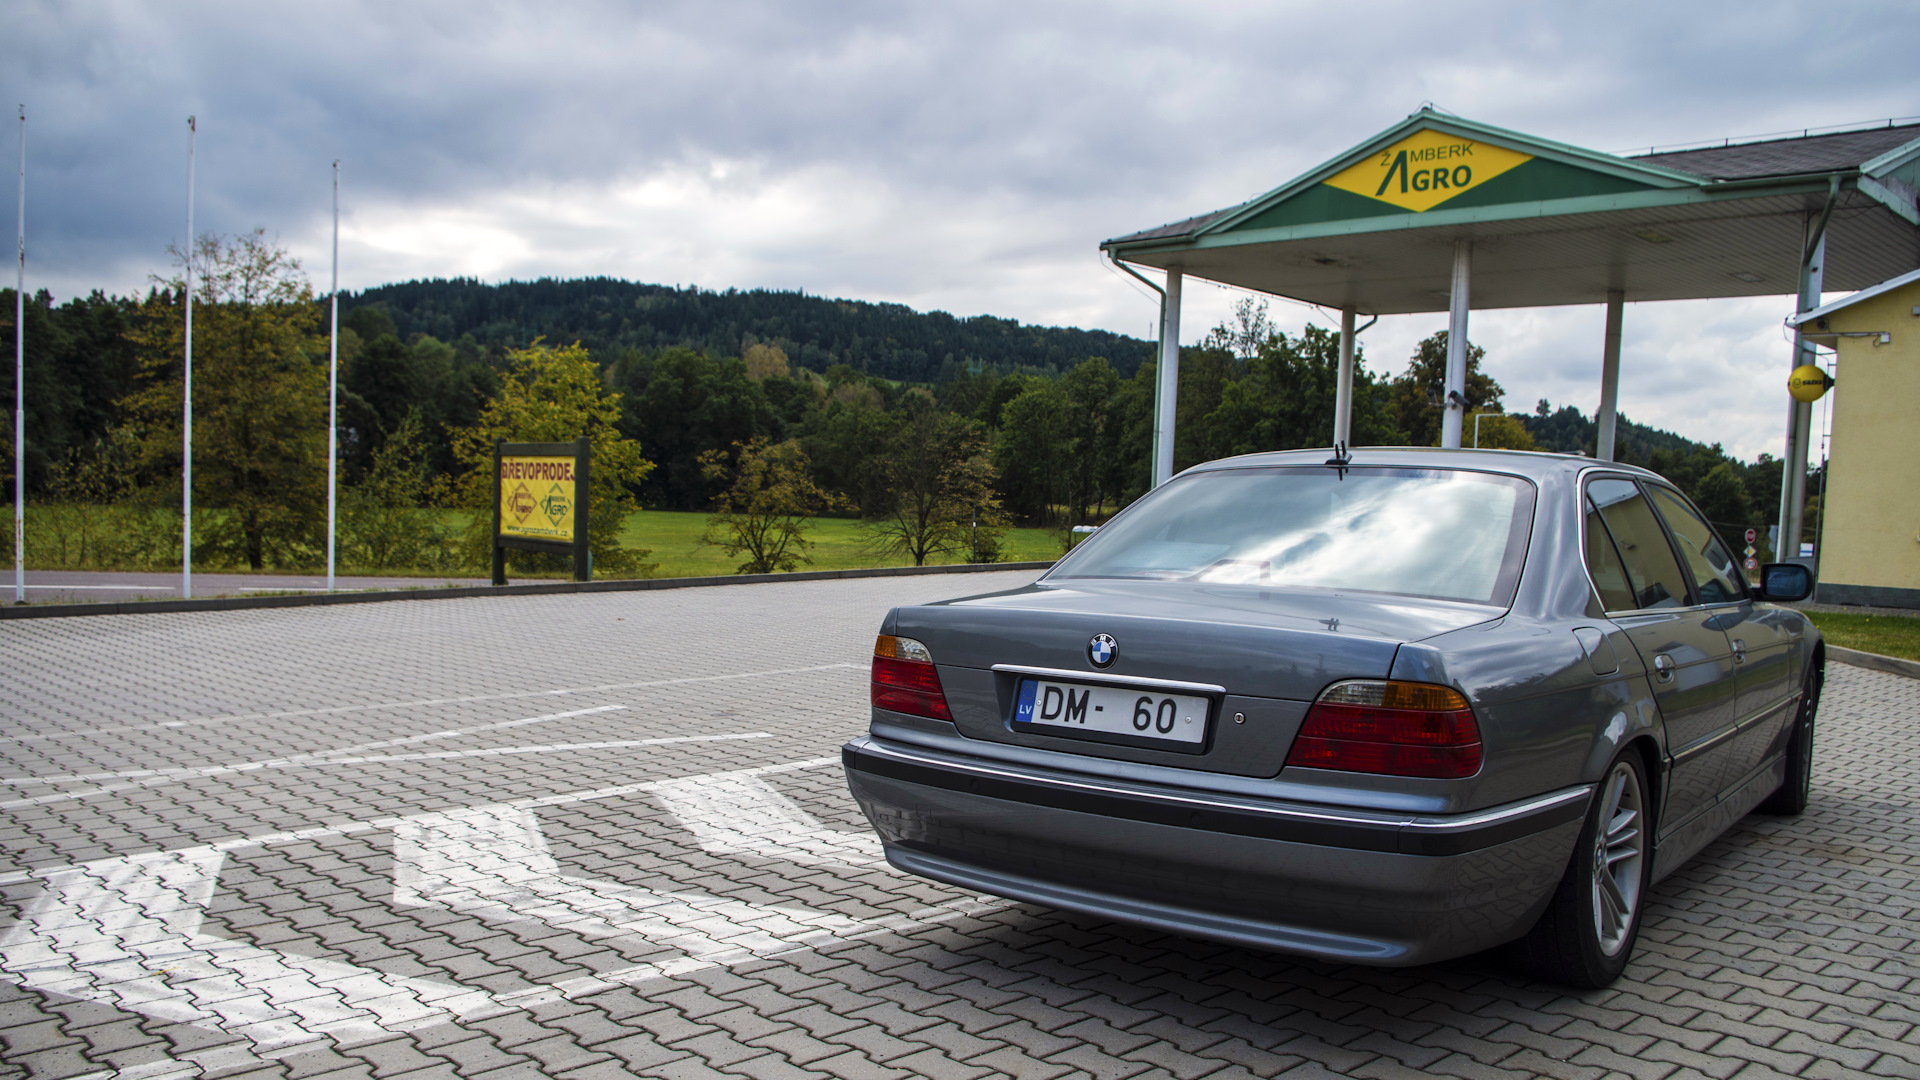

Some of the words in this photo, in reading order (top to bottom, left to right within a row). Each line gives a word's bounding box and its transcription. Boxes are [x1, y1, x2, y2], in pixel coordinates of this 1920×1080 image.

[1375, 150, 1472, 196] AGRO
[1090, 635, 1116, 648] BMW
[1018, 704, 1033, 715] LV
[1132, 695, 1177, 734] 60
